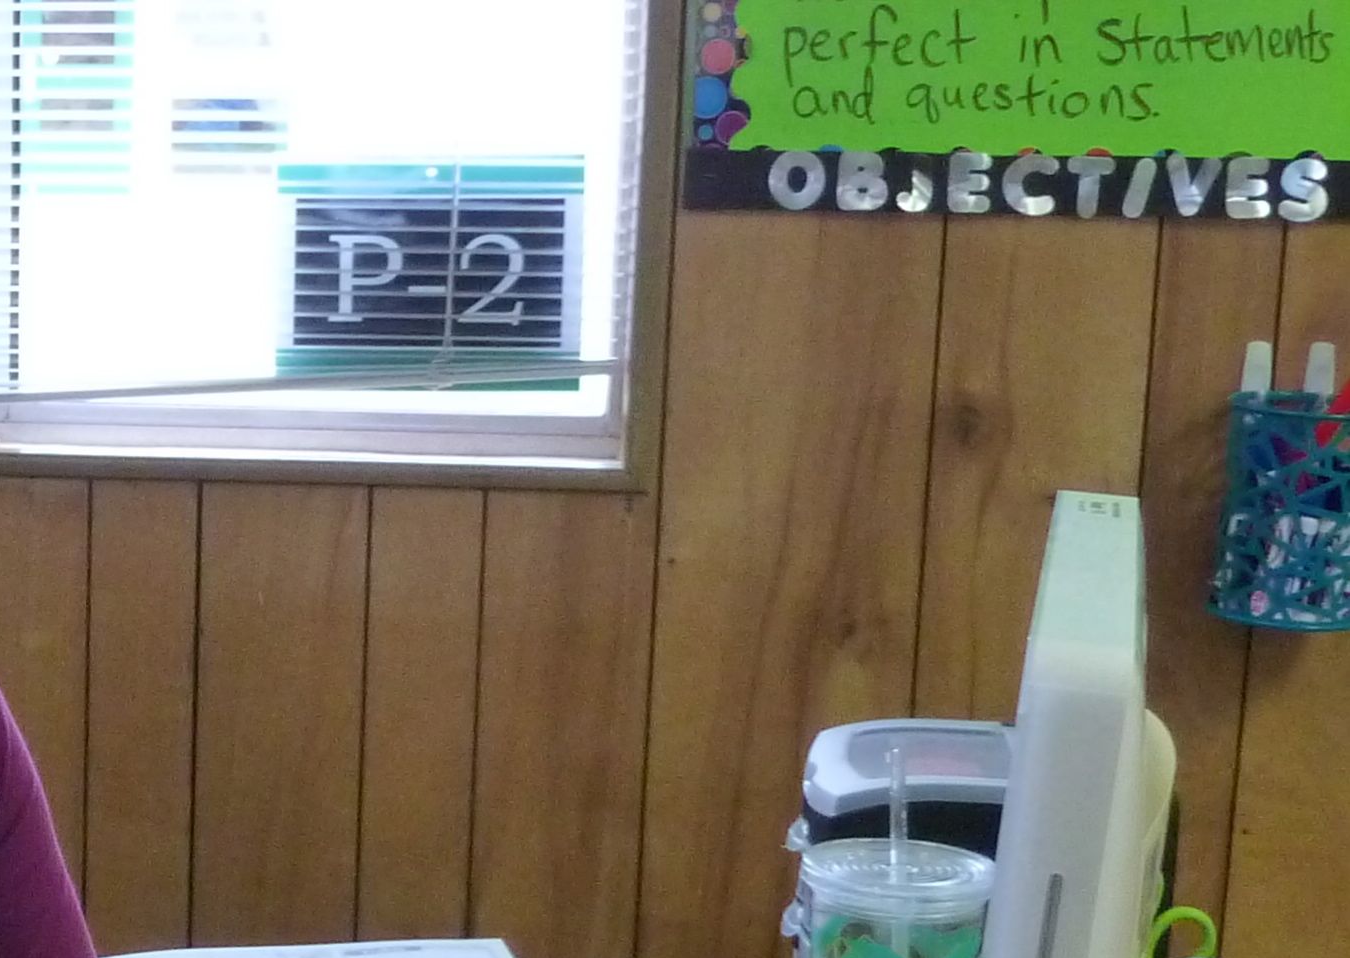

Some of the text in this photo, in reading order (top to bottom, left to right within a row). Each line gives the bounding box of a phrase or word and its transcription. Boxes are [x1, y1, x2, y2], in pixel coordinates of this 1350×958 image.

[783, 4, 977, 87] perfect
[1014, 12, 1063, 67] in
[792, 65, 1160, 125] and questions.
[767, 148, 1331, 222] OBJECTIVES
[327, 233, 525, 326] P-2
